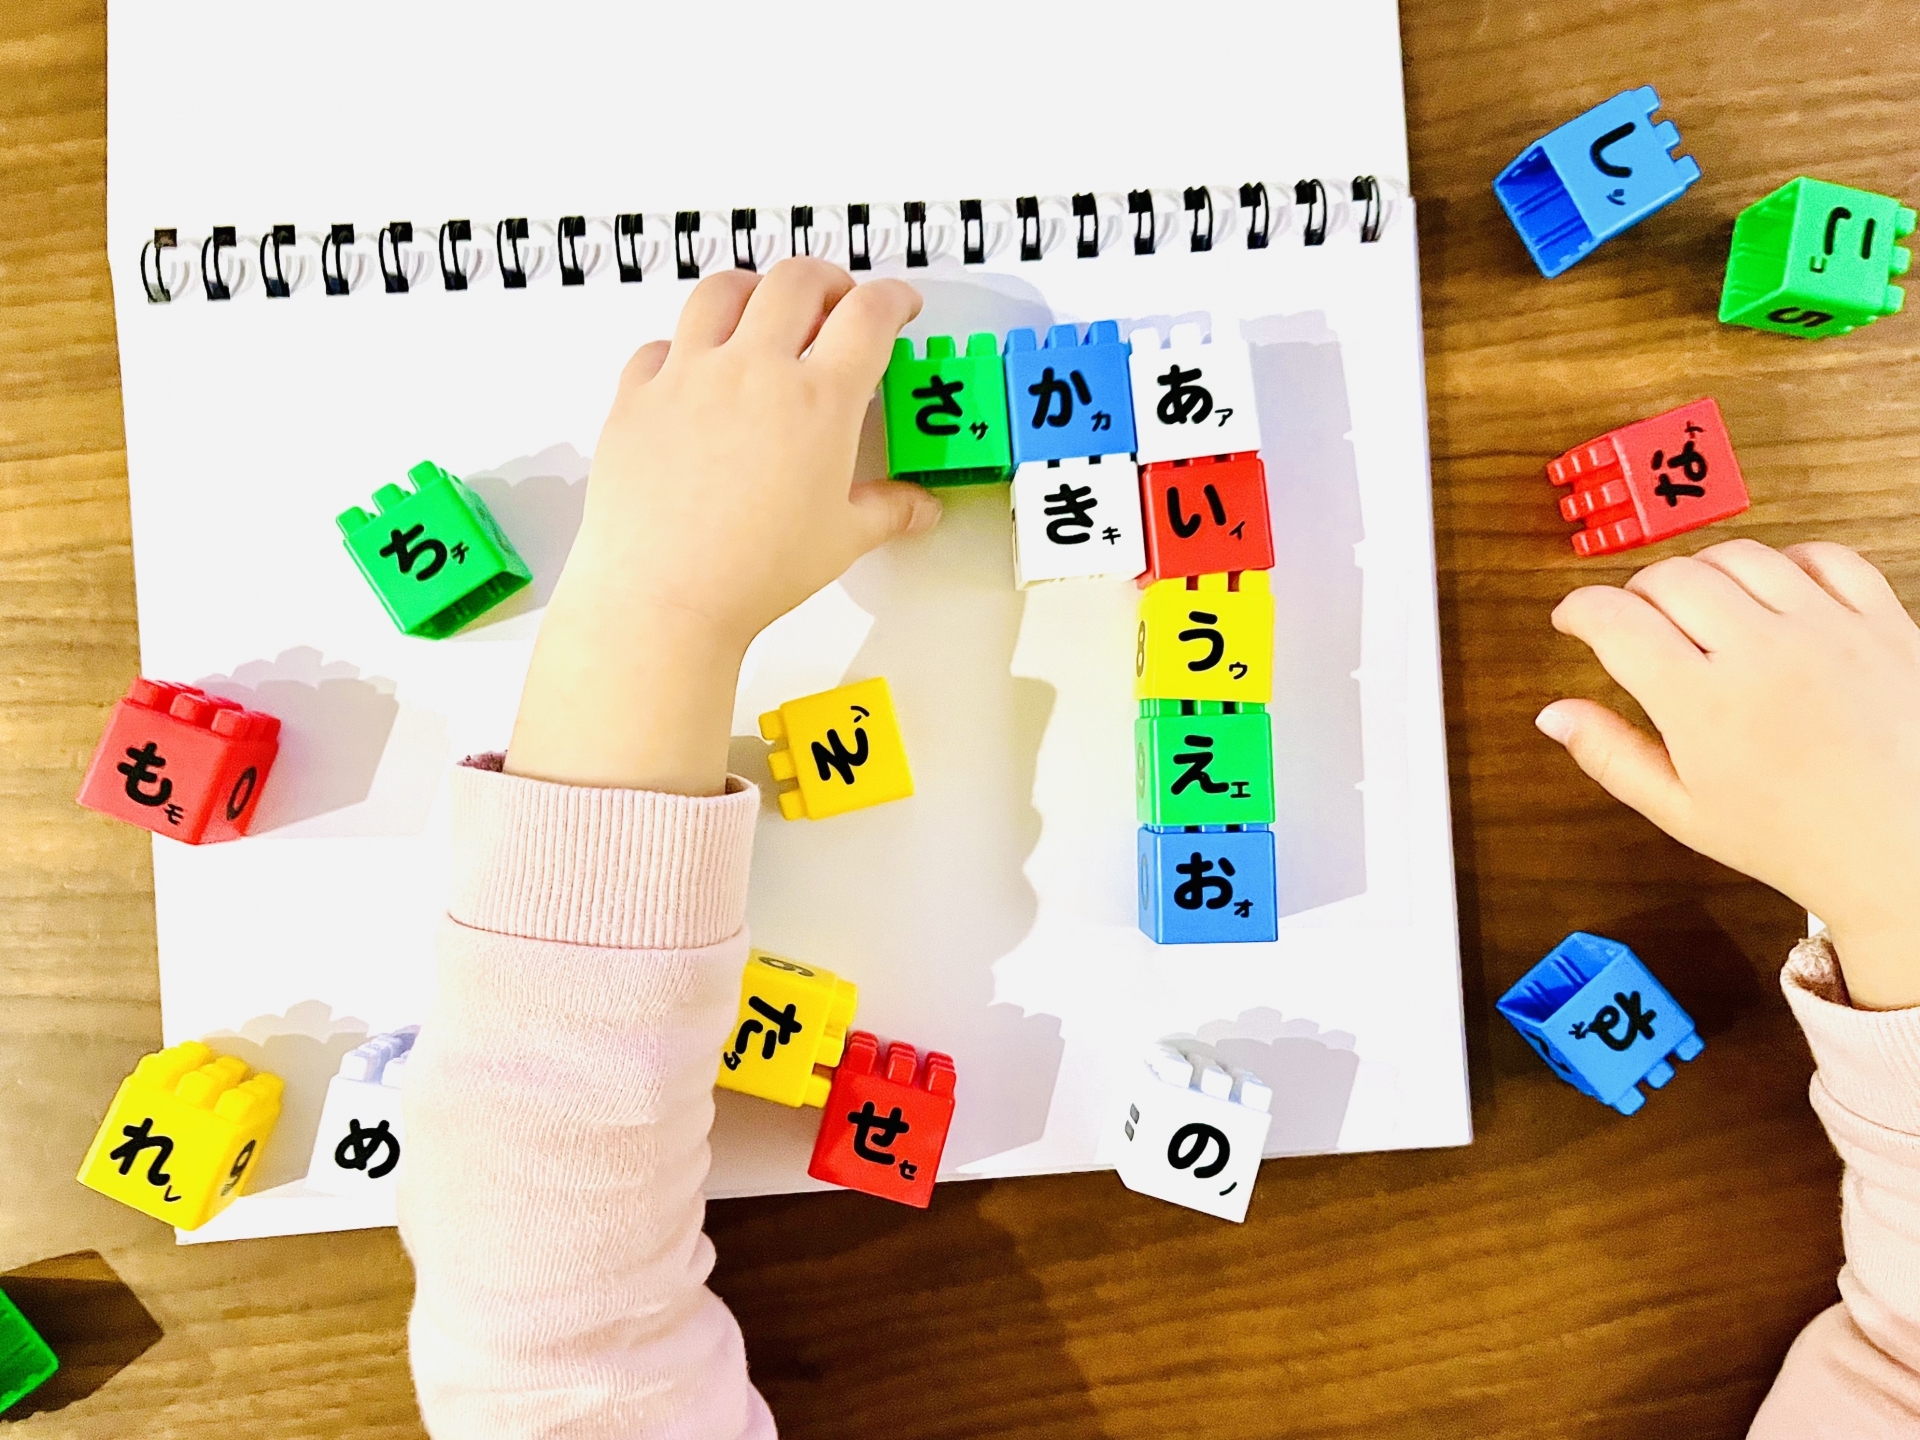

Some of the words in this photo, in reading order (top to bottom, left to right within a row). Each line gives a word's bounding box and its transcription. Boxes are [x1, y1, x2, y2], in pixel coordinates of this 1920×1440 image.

[912, 375, 964, 436] さ
[1028, 367, 1093, 429] か
[1091, 411, 1111, 432] カ
[1157, 365, 1214, 425] あ
[969, 421, 989, 440] サ
[1651, 440, 1708, 507] な
[1044, 484, 1098, 545] き
[1101, 527, 1122, 545] キ
[1167, 484, 1227, 538] い
[1229, 521, 1245, 539] イ
[379, 524, 448, 582] ち
[450, 541, 470, 565] チ
[1178, 610, 1225, 672] う
[117, 741, 173, 807] も
[811, 727, 869, 785] そ
[1170, 735, 1229, 795] え
[163, 803, 184, 826] モ
[1173, 852, 1236, 910] お
[735, 995, 803, 1060] た
[1588, 990, 1657, 1051] ね
[109, 1117, 174, 1187] れ
[334, 1118, 401, 1179] め
[847, 1101, 910, 1165] せ
[1167, 1122, 1231, 1179] の
[898, 1159, 917, 1181] セ
